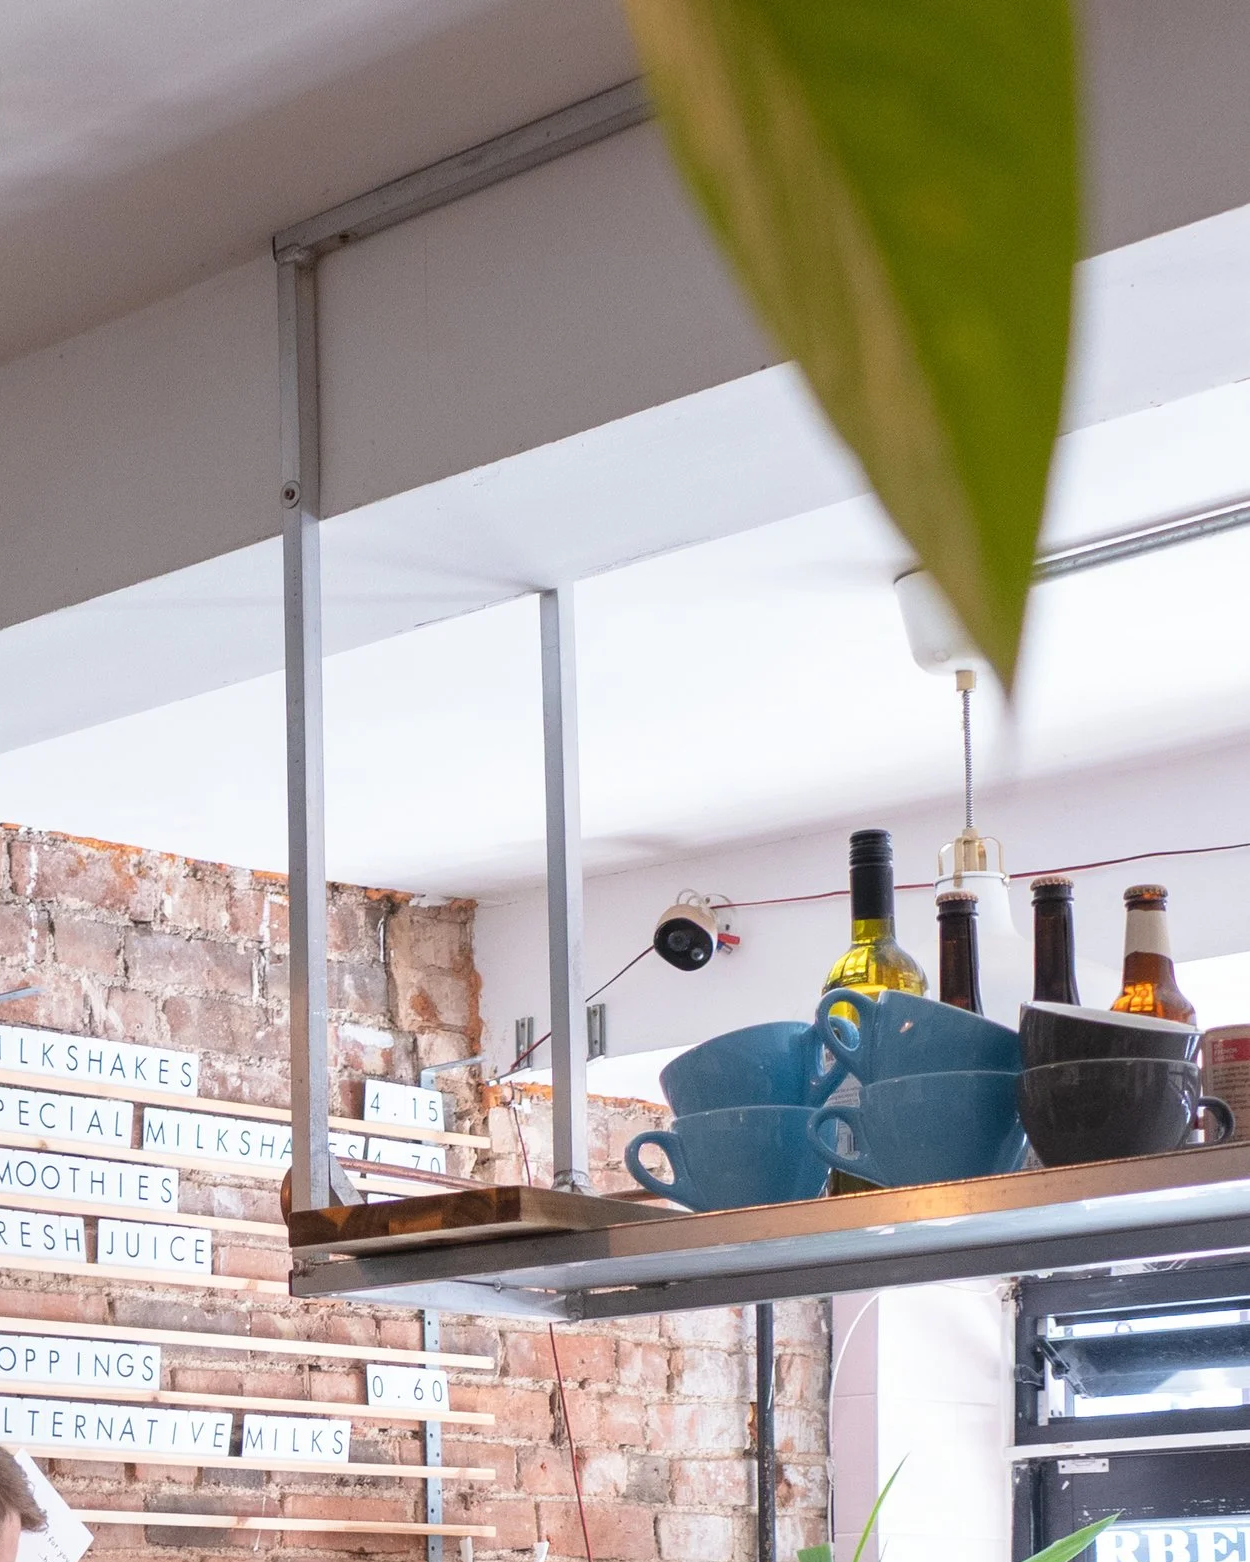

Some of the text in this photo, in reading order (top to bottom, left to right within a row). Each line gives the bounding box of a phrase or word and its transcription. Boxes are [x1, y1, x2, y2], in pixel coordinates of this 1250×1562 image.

[370, 1092, 438, 1122] 4.15
[106, 1230, 205, 1265] JUICE
[372, 1375, 444, 1403] 0.60
[243, 1426, 344, 1456] MILKS
